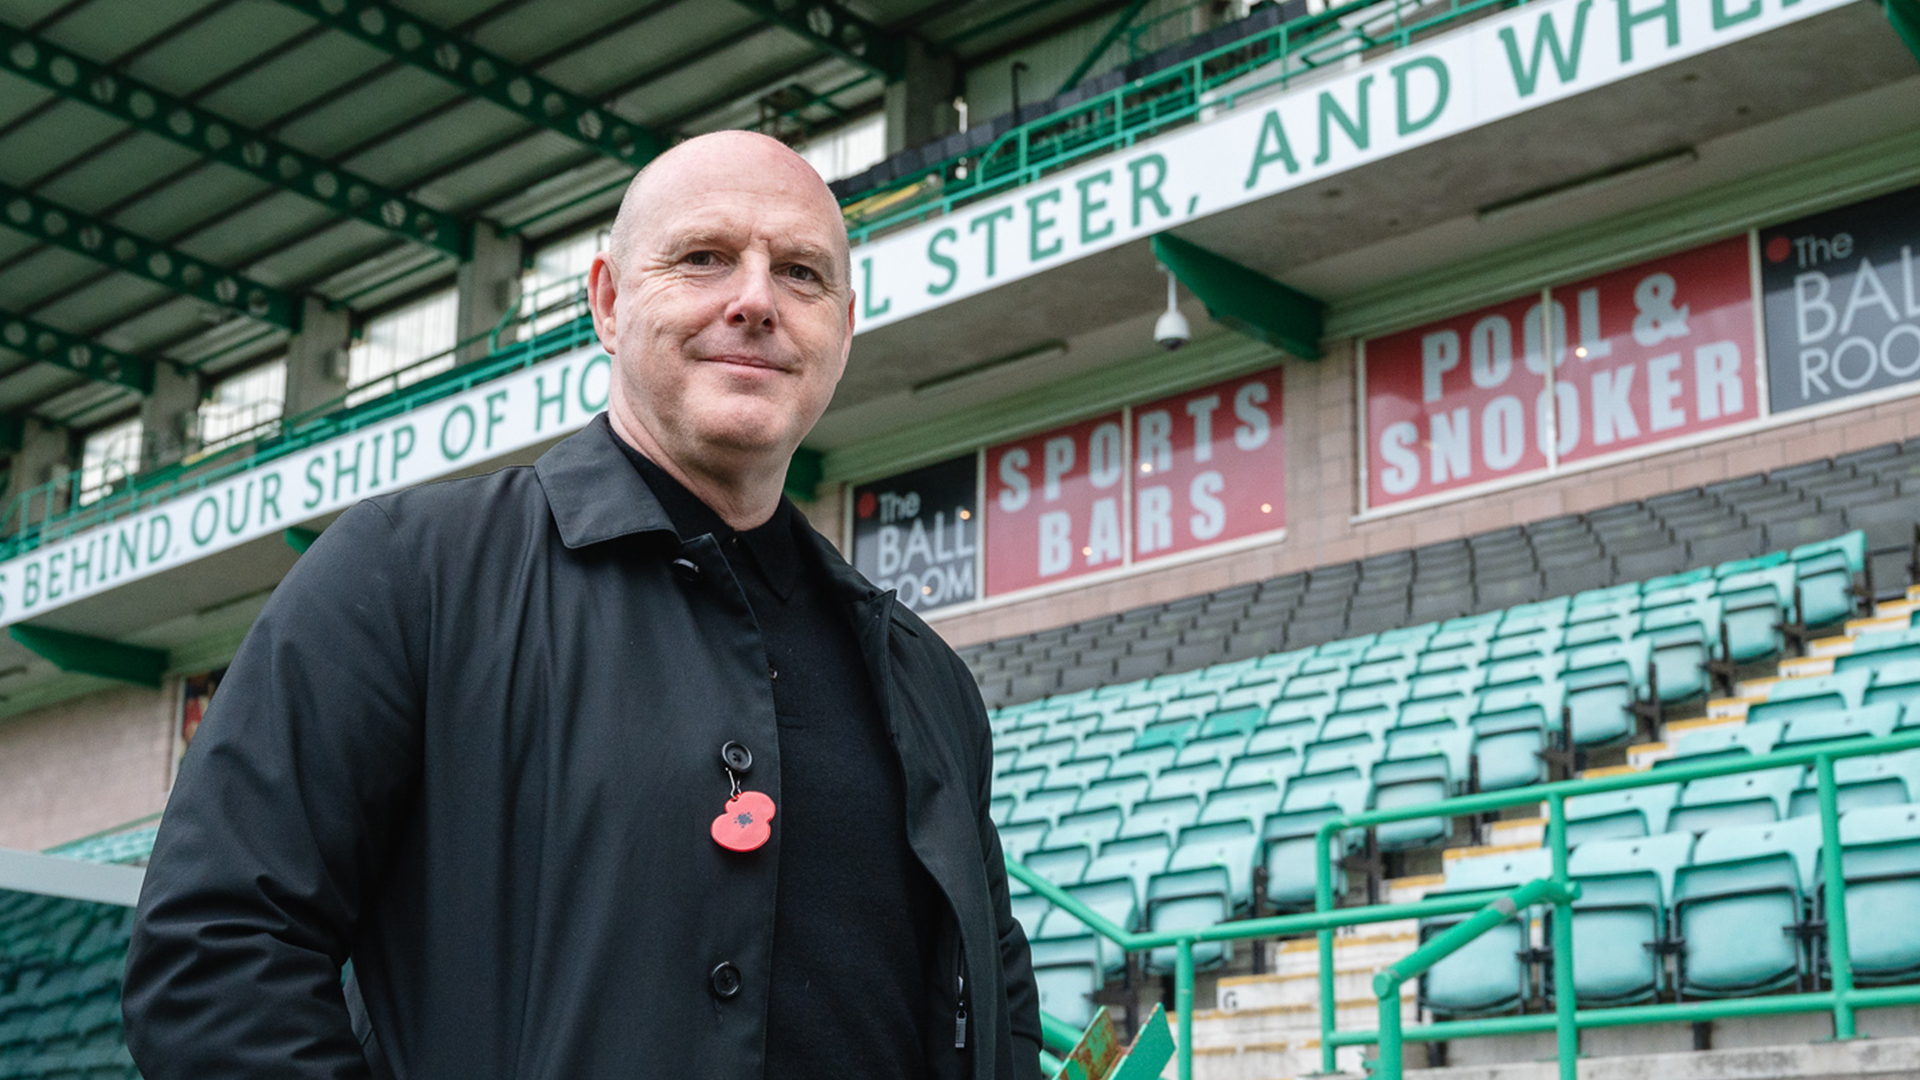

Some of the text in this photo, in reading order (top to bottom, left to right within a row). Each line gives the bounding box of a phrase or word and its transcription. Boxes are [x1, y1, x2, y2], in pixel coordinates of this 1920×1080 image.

[1794, 232, 1854, 268] The
[191, 472, 283, 547] OUR
[303, 425, 416, 510] SHIP
[440, 389, 508, 462] OF
[926, 153, 1199, 296] STEER,
[1244, 55, 1450, 190] AND
[1421, 272, 1690, 402] POOL &
[1800, 324, 1920, 400] ROO
[998, 382, 1271, 512] SPORTS
[1380, 340, 1744, 495] SNOOKER
[878, 505, 975, 578] BALL
[879, 491, 921, 524] The
[1038, 471, 1227, 578] BARS
[878, 561, 974, 610] OOM
[1223, 990, 1238, 1010] G
